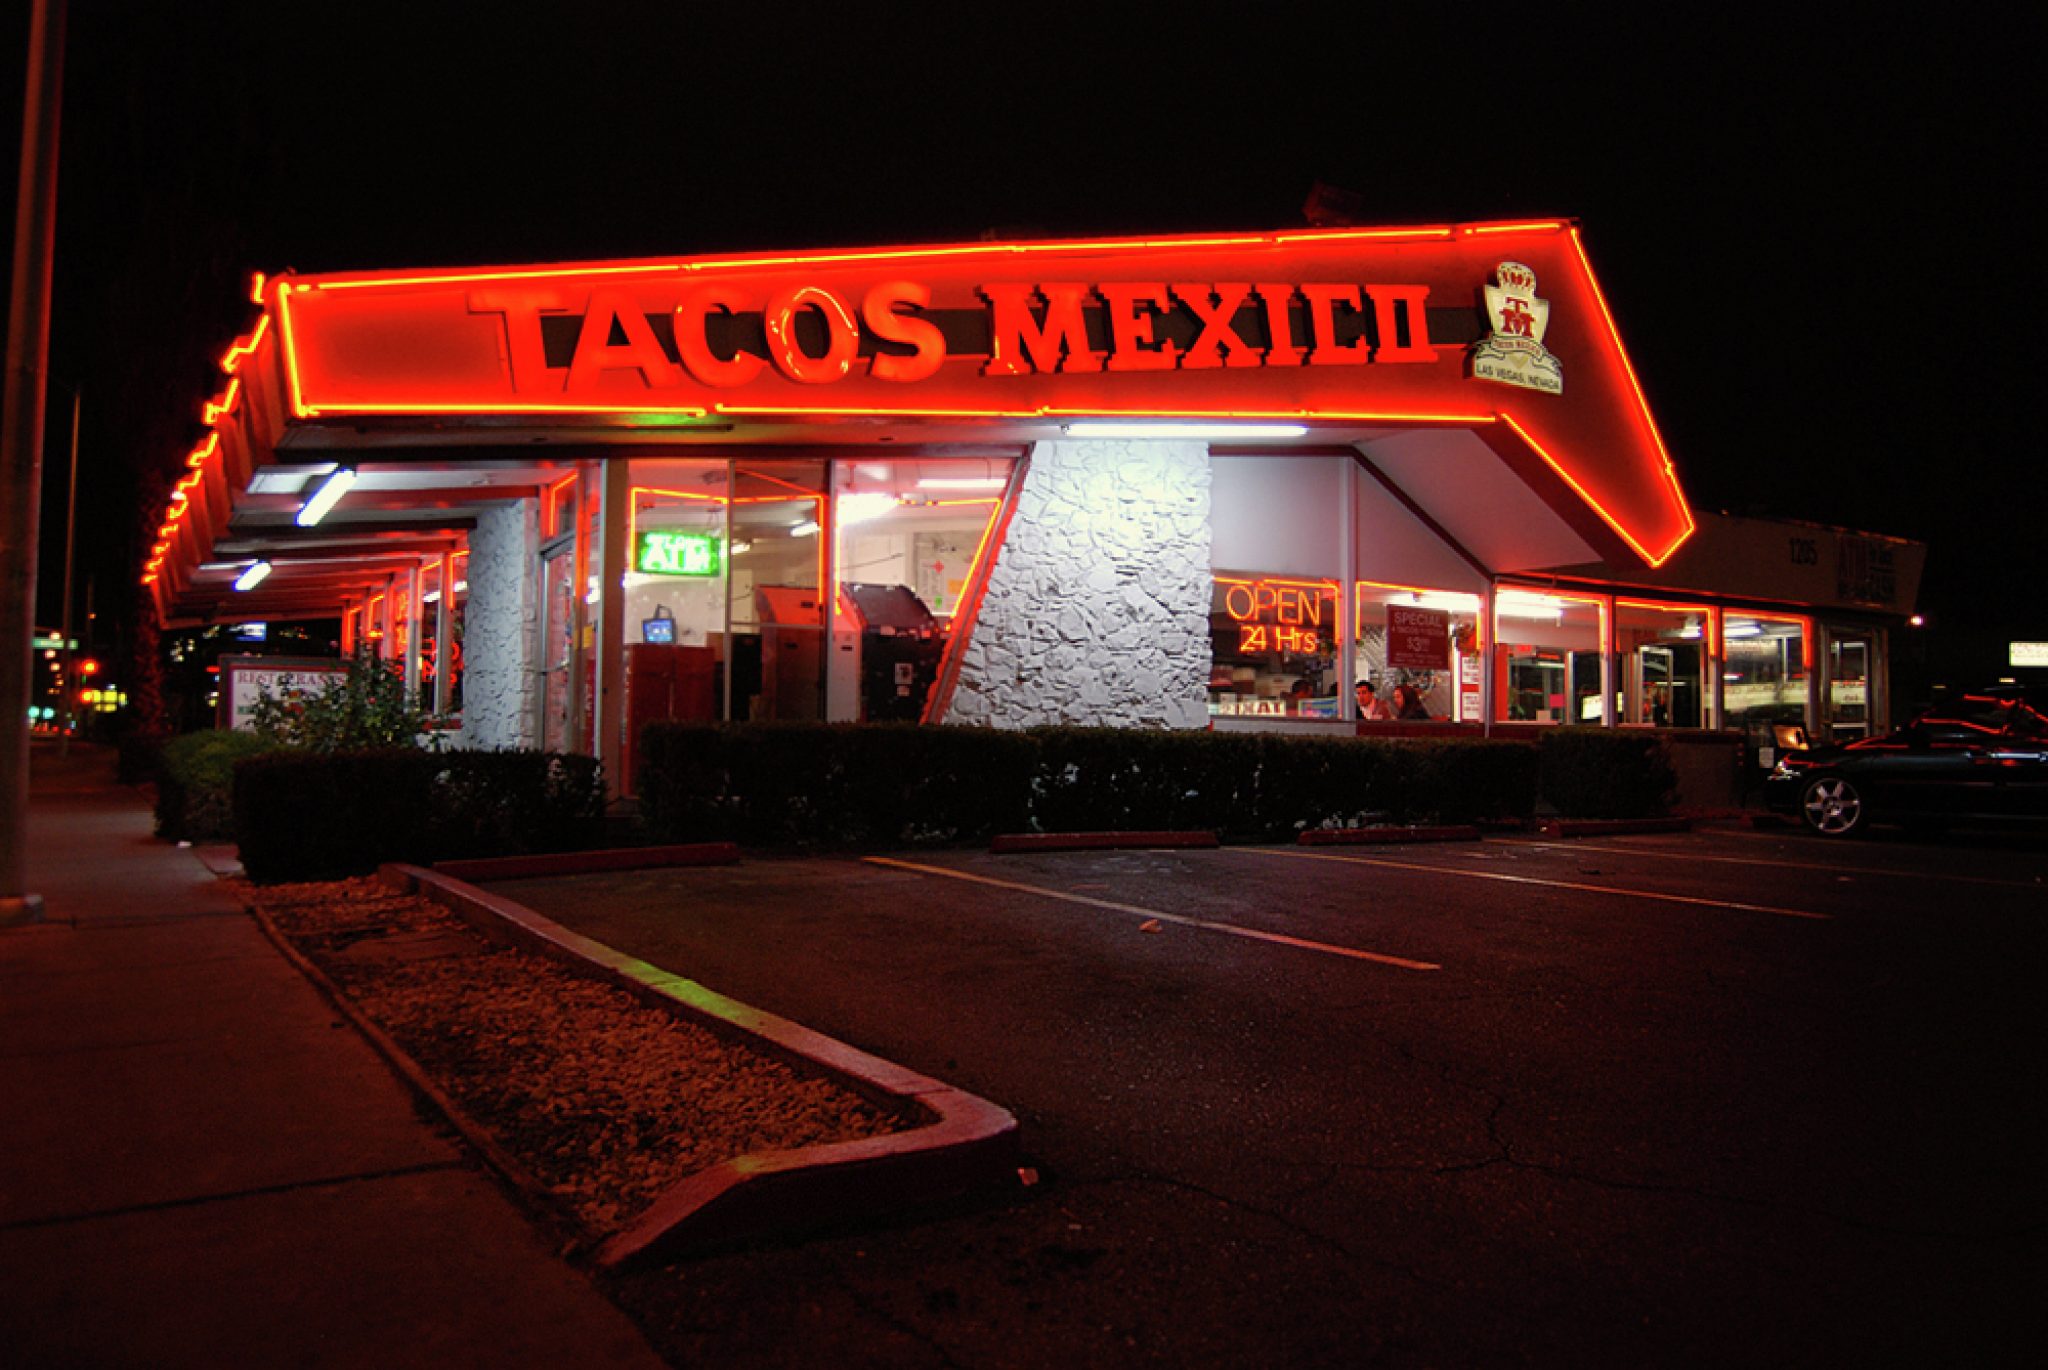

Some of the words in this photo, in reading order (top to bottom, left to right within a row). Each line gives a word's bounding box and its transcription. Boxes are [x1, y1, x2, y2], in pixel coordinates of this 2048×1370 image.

[468, 281, 946, 391] TACOS
[978, 282, 1438, 375] MEXICO
[1226, 585, 1321, 626] OPEN
[1394, 611, 1443, 627] SPECIAL
[1240, 624, 1267, 653] 24
[1275, 624, 1317, 654] Hrs
